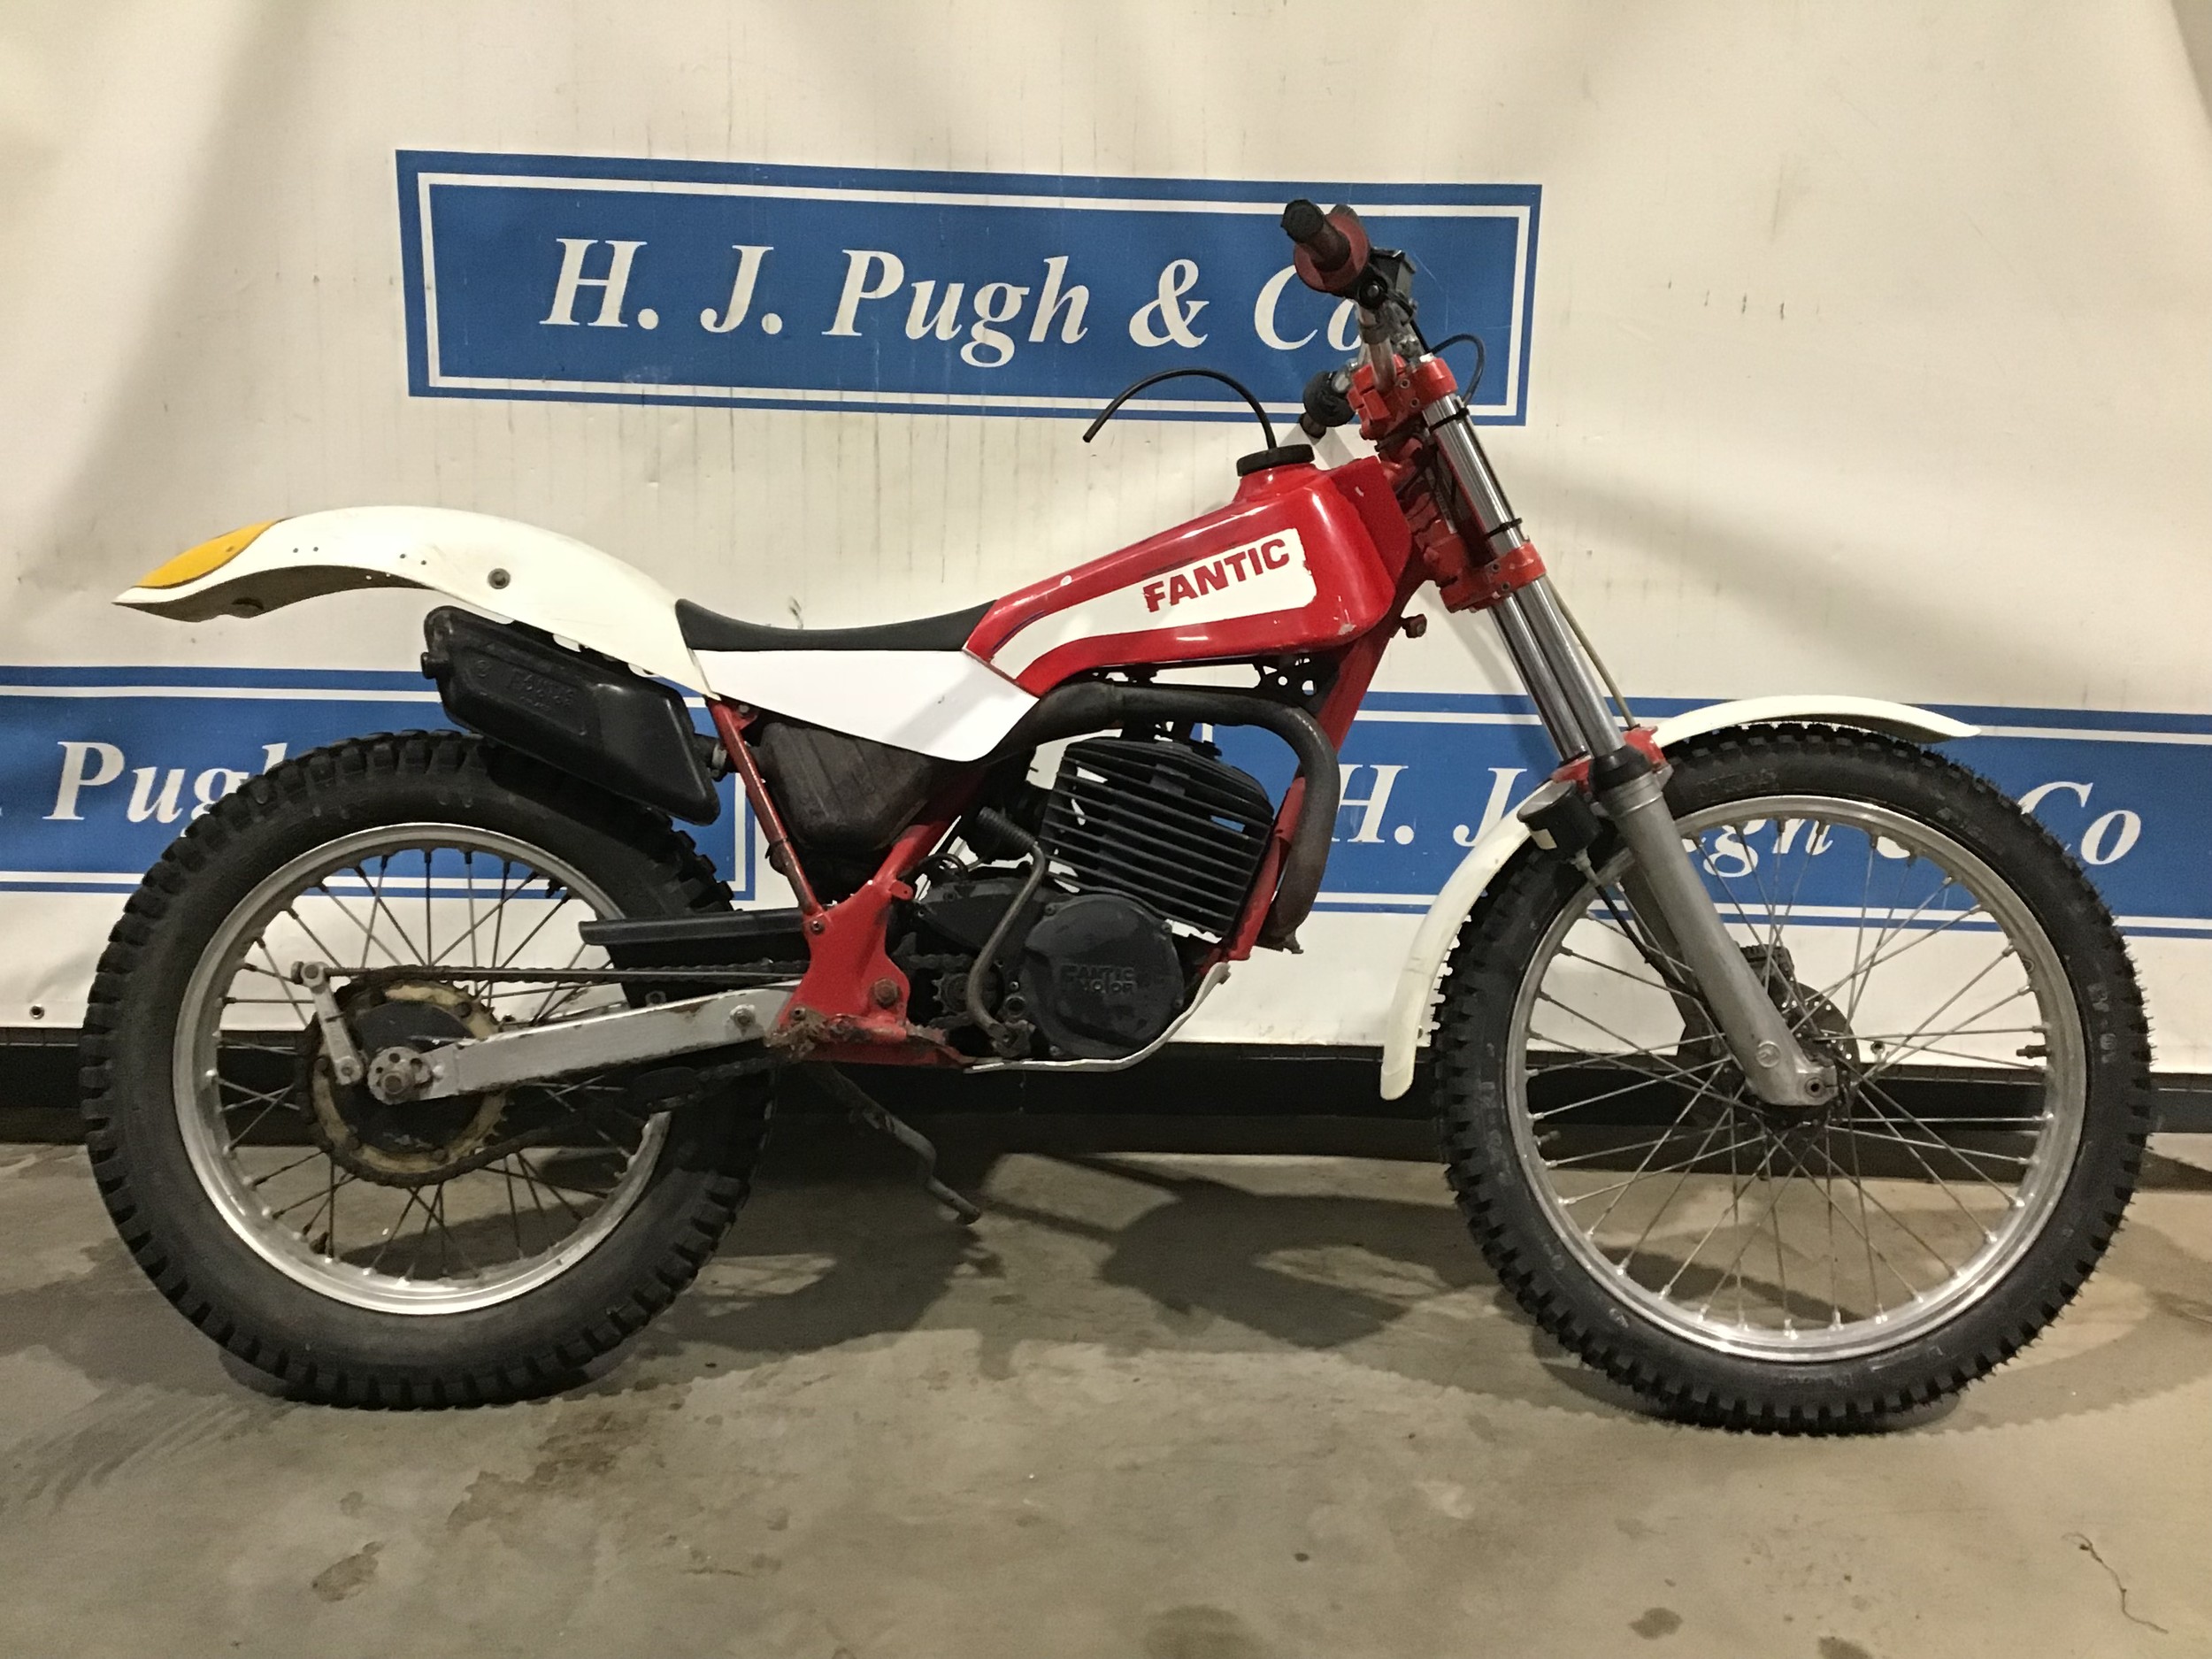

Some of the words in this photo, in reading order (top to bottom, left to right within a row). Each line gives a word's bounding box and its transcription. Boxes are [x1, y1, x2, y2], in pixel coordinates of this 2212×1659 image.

[539, 237, 659, 330] H.
[700, 244, 783, 335] J.
[821, 249, 1089, 368] Pugh
[1129, 258, 1210, 349] &
[1142, 538, 1290, 612] FANTIC
[42, 741, 288, 838] Pug
[1452, 767, 1528, 848] J
